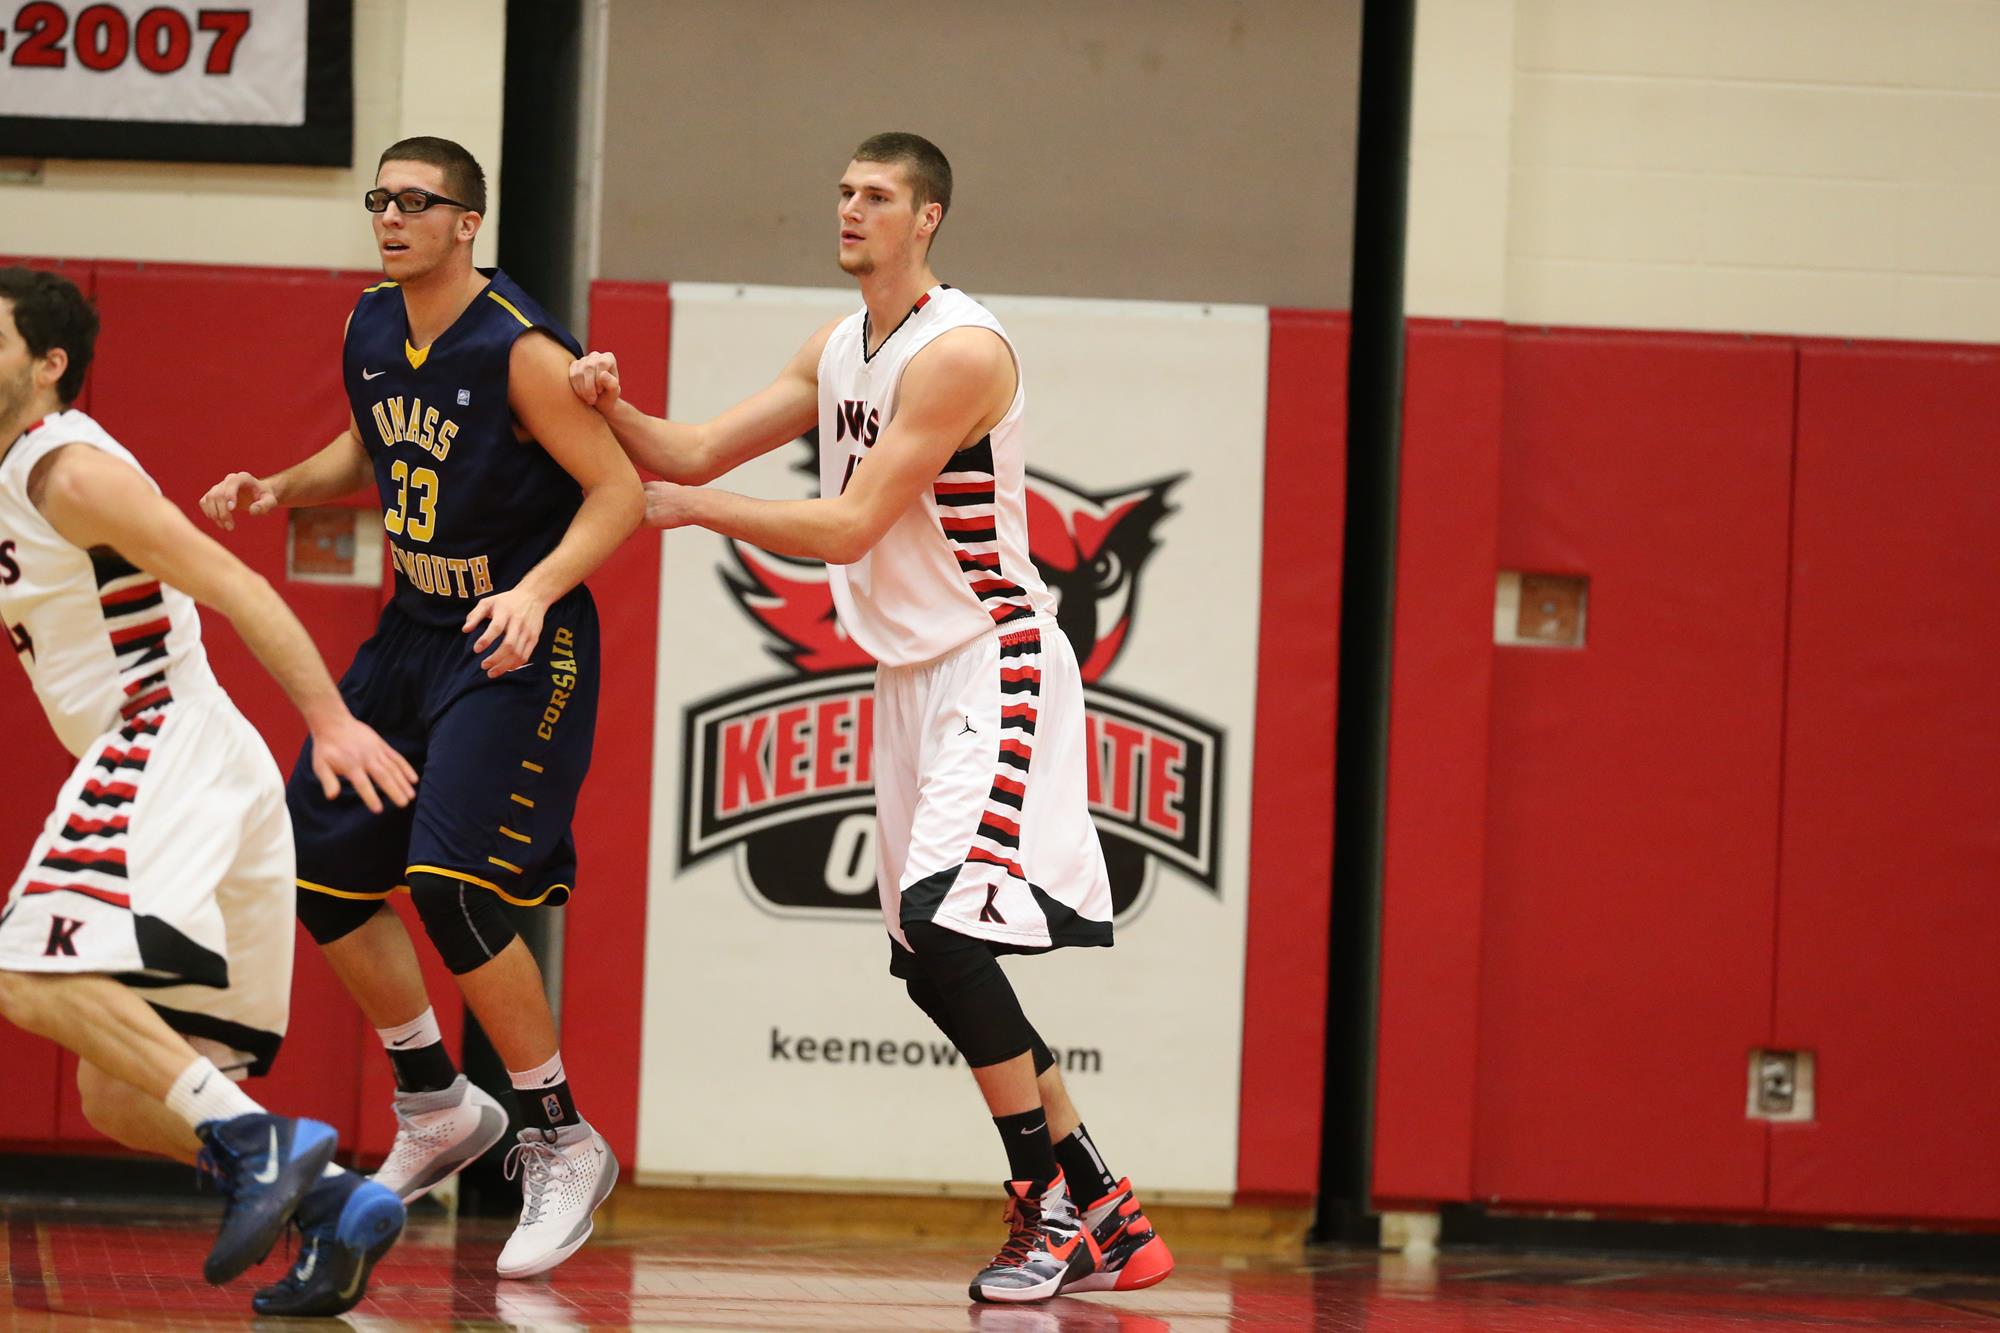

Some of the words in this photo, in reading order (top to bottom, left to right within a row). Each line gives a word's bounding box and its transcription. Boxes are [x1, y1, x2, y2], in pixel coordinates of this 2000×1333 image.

[0, 1, 251, 75] 2007
[371, 396, 459, 462] UMASS
[384, 459, 439, 543] 33
[537, 626, 578, 741] CORSAIR
[42, 914, 85, 957] K
[976, 882, 1009, 926] K
